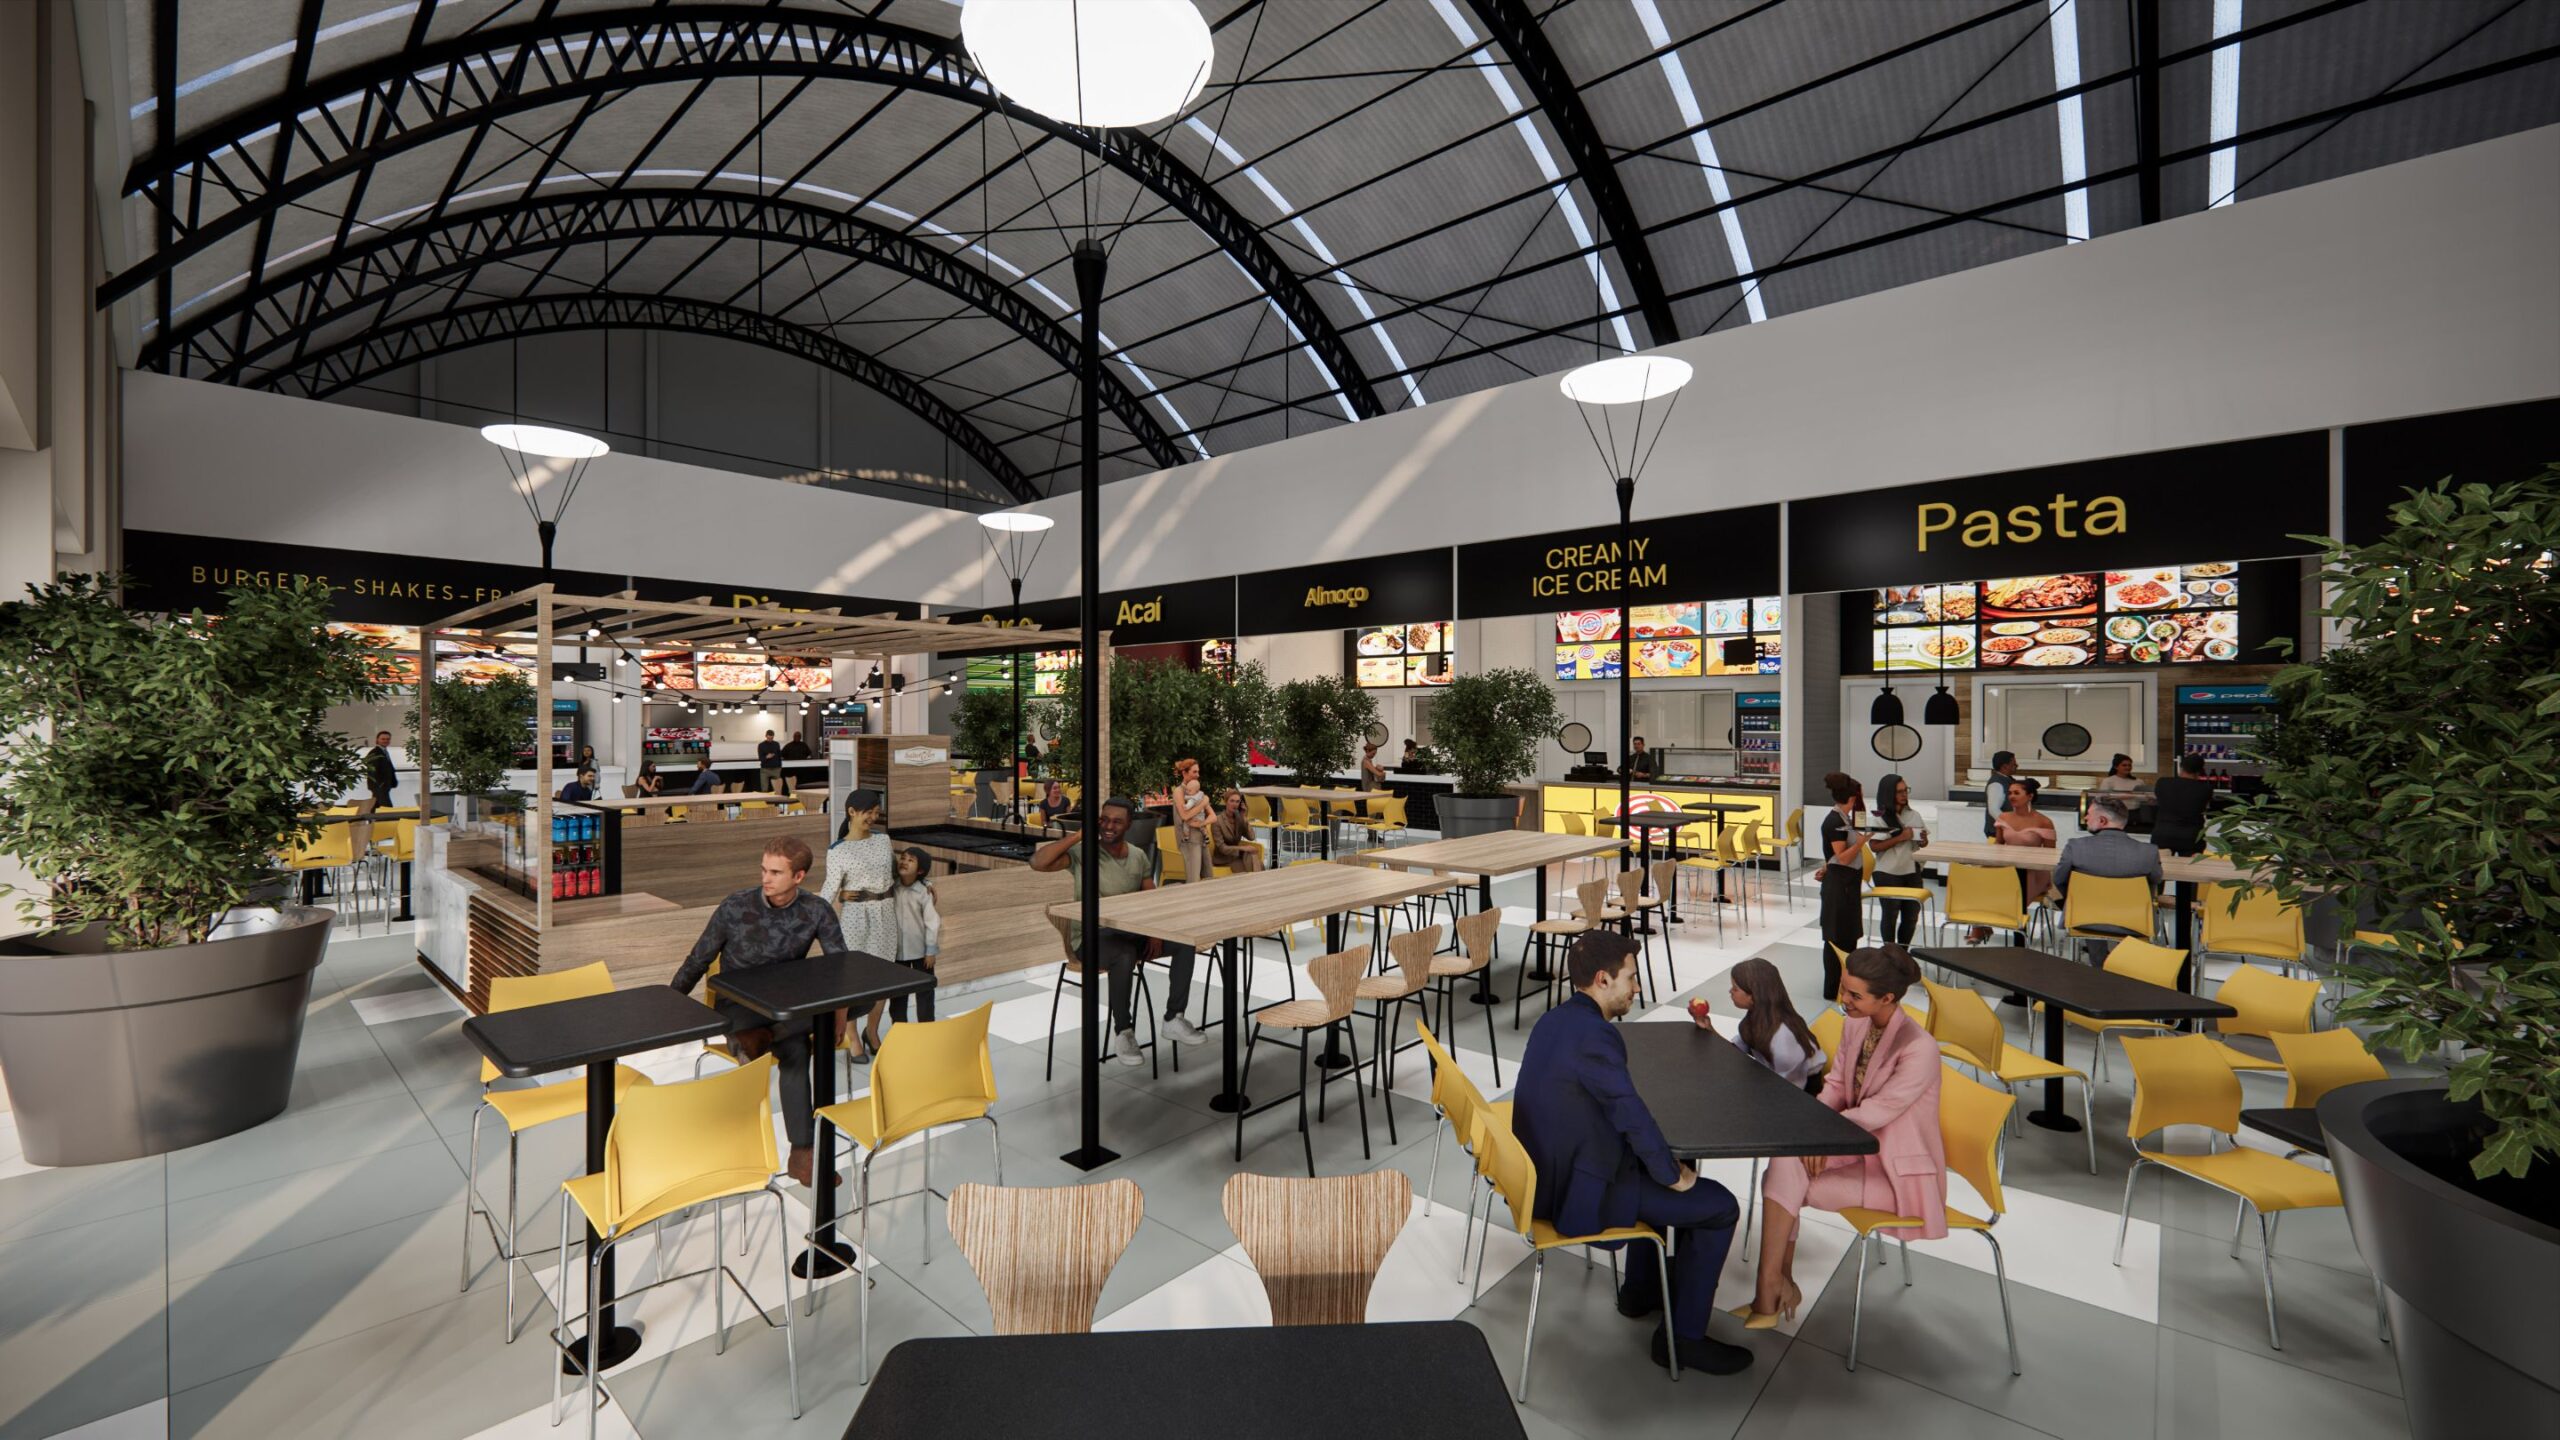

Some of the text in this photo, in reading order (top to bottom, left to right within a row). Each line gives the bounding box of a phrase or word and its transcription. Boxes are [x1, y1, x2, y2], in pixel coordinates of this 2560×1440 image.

[1917, 493, 2127, 552] Pasta
[1545, 537, 1650, 570] CREAMY
[1304, 585, 1369, 608] Almoço
[1532, 563, 1668, 598] ICE CREAM
[1115, 595, 1163, 626] Acaí
